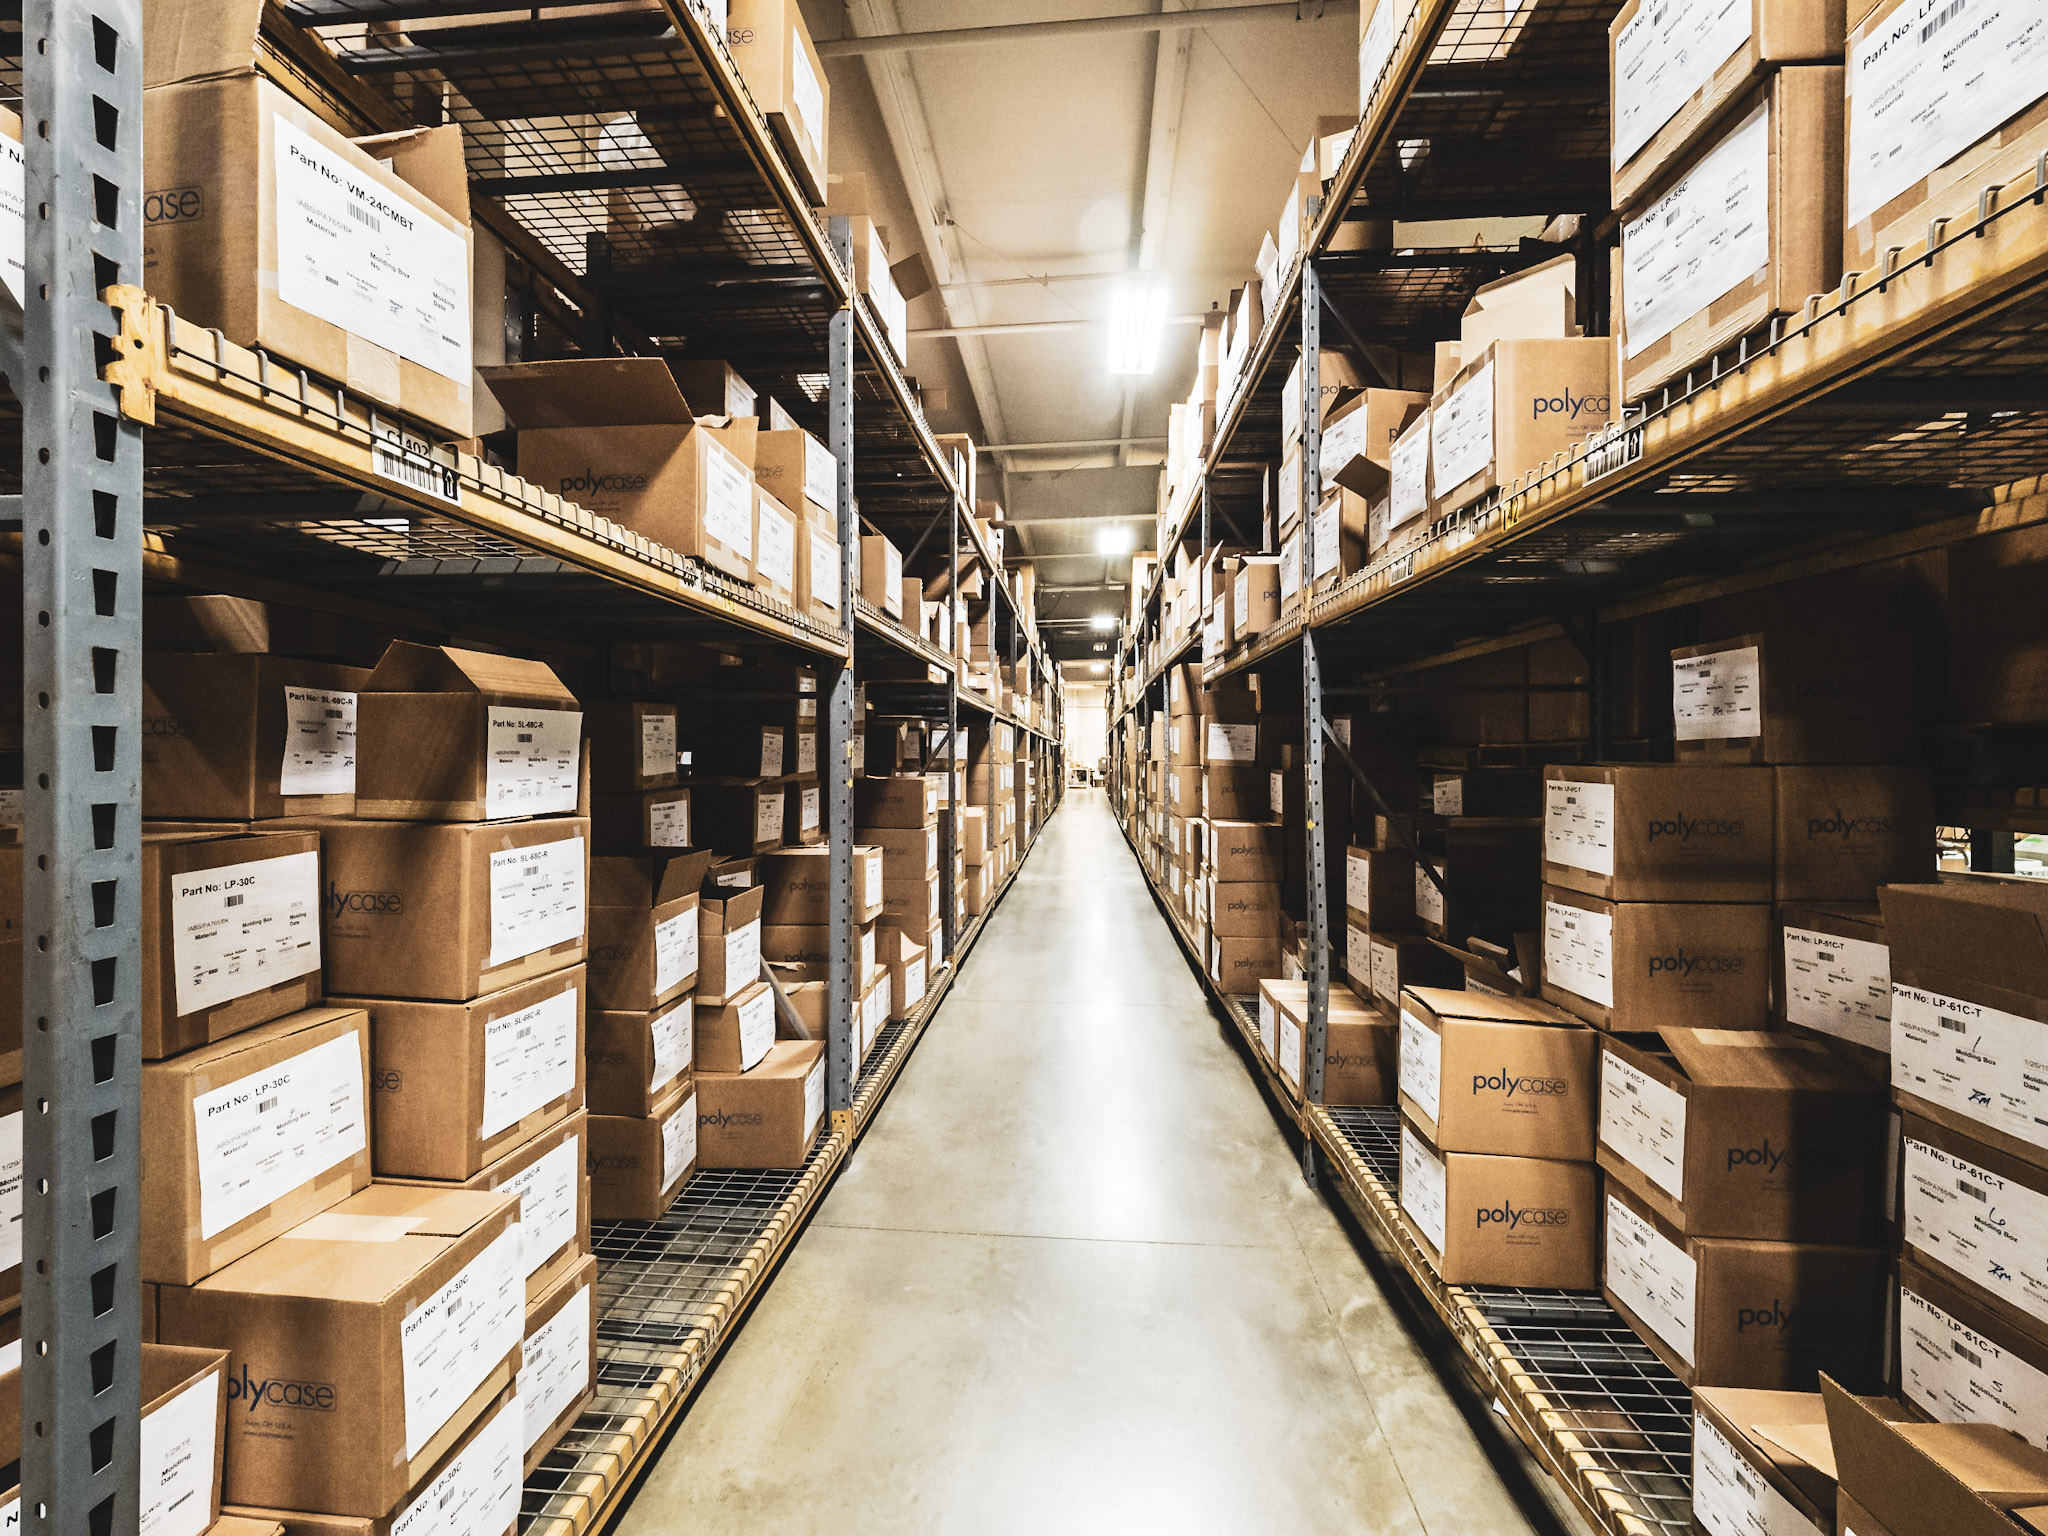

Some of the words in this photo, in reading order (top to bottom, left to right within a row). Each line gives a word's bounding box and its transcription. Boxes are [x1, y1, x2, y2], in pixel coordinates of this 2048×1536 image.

[1618, 27, 1634, 50] Part
[1863, 40, 1888, 70] Part
[1891, 18, 1914, 45] No:
[1942, 29, 1979, 61] Molding
[1981, 11, 2000, 29] Box
[1965, 71, 1985, 88] Name
[1874, 91, 1904, 119] Material
[289, 144, 317, 171] Part
[321, 166, 343, 187] No:
[346, 181, 415, 232] VM-24CMBT
[1725, 184, 1749, 205] Molding
[1725, 199, 1739, 213] Date
[306, 216, 338, 240] Material
[1627, 219, 1644, 240] Part
[1645, 208, 1659, 226] No:
[370, 252, 397, 273] Molding
[397, 266, 410, 279] Box
[432, 291, 456, 310] Molding
[432, 300, 447, 312] Date
[1533, 387, 1610, 420] polyca
[560, 468, 647, 497] polycase
[289, 692, 305, 700] Part
[306, 694, 320, 702] No:
[493, 720, 505, 728] Part
[506, 720, 517, 728] No:
[1649, 812, 1744, 842] polycase
[493, 859, 506, 868] Part
[182, 886, 203, 898] Part
[205, 883, 221, 893] No:
[224, 876, 256, 890] LP-30C
[329, 880, 401, 919] lycase
[194, 930, 218, 940] Material
[242, 919, 263, 929] Molding
[1786, 932, 1800, 941] Part
[1801, 935, 1812, 943] No:
[1649, 948, 1743, 977] polycase
[1892, 986, 1911, 999] Part
[1913, 992, 1929, 1004] No:
[1932, 997, 1982, 1018] LP-61C-T
[1905, 1032, 1928, 1045] Material
[1955, 1047, 1982, 1062] Molding
[1983, 1055, 1997, 1066] Box
[1472, 1068, 1567, 1097] polycase
[2023, 1081, 2040, 1092] Date
[208, 1100, 231, 1117] Part
[233, 1093, 252, 1106] No:
[255, 1074, 291, 1096] LP-30C
[276, 1116, 299, 1130] Molding
[299, 1110, 311, 1119] Box
[698, 1108, 763, 1129] polycase
[222, 1141, 249, 1157] Material
[1905, 1137, 1928, 1155] Part
[1930, 1148, 1948, 1164] No:
[1952, 1159, 2005, 1191] LP-61C-T
[0, 1184, 19, 1196] Date
[1919, 1187, 1944, 1203] Material
[1476, 1200, 1568, 1230] polycase
[1974, 1215, 2002, 1235] Molding
[2003, 1231, 2018, 1243] Box
[405, 1315, 422, 1337] Part
[424, 1302, 439, 1320] No:
[441, 1274, 469, 1304] LP-30C
[1902, 1288, 1925, 1309] Part
[1926, 1304, 1944, 1322] No:
[1947, 1318, 2001, 1360] LP-61C-T
[1915, 1340, 1940, 1361] Material
[228, 1363, 334, 1412] olycase
[1969, 1379, 2001, 1405] Molding
[2002, 1400, 2018, 1415] Box
[1696, 1412, 1712, 1433] Part
[1713, 1429, 1727, 1449] No:
[161, 1453, 192, 1477] Molding
[160, 1471, 178, 1487] Date
[415, 1496, 431, 1516] No:
[433, 1461, 463, 1497] LP-30C
